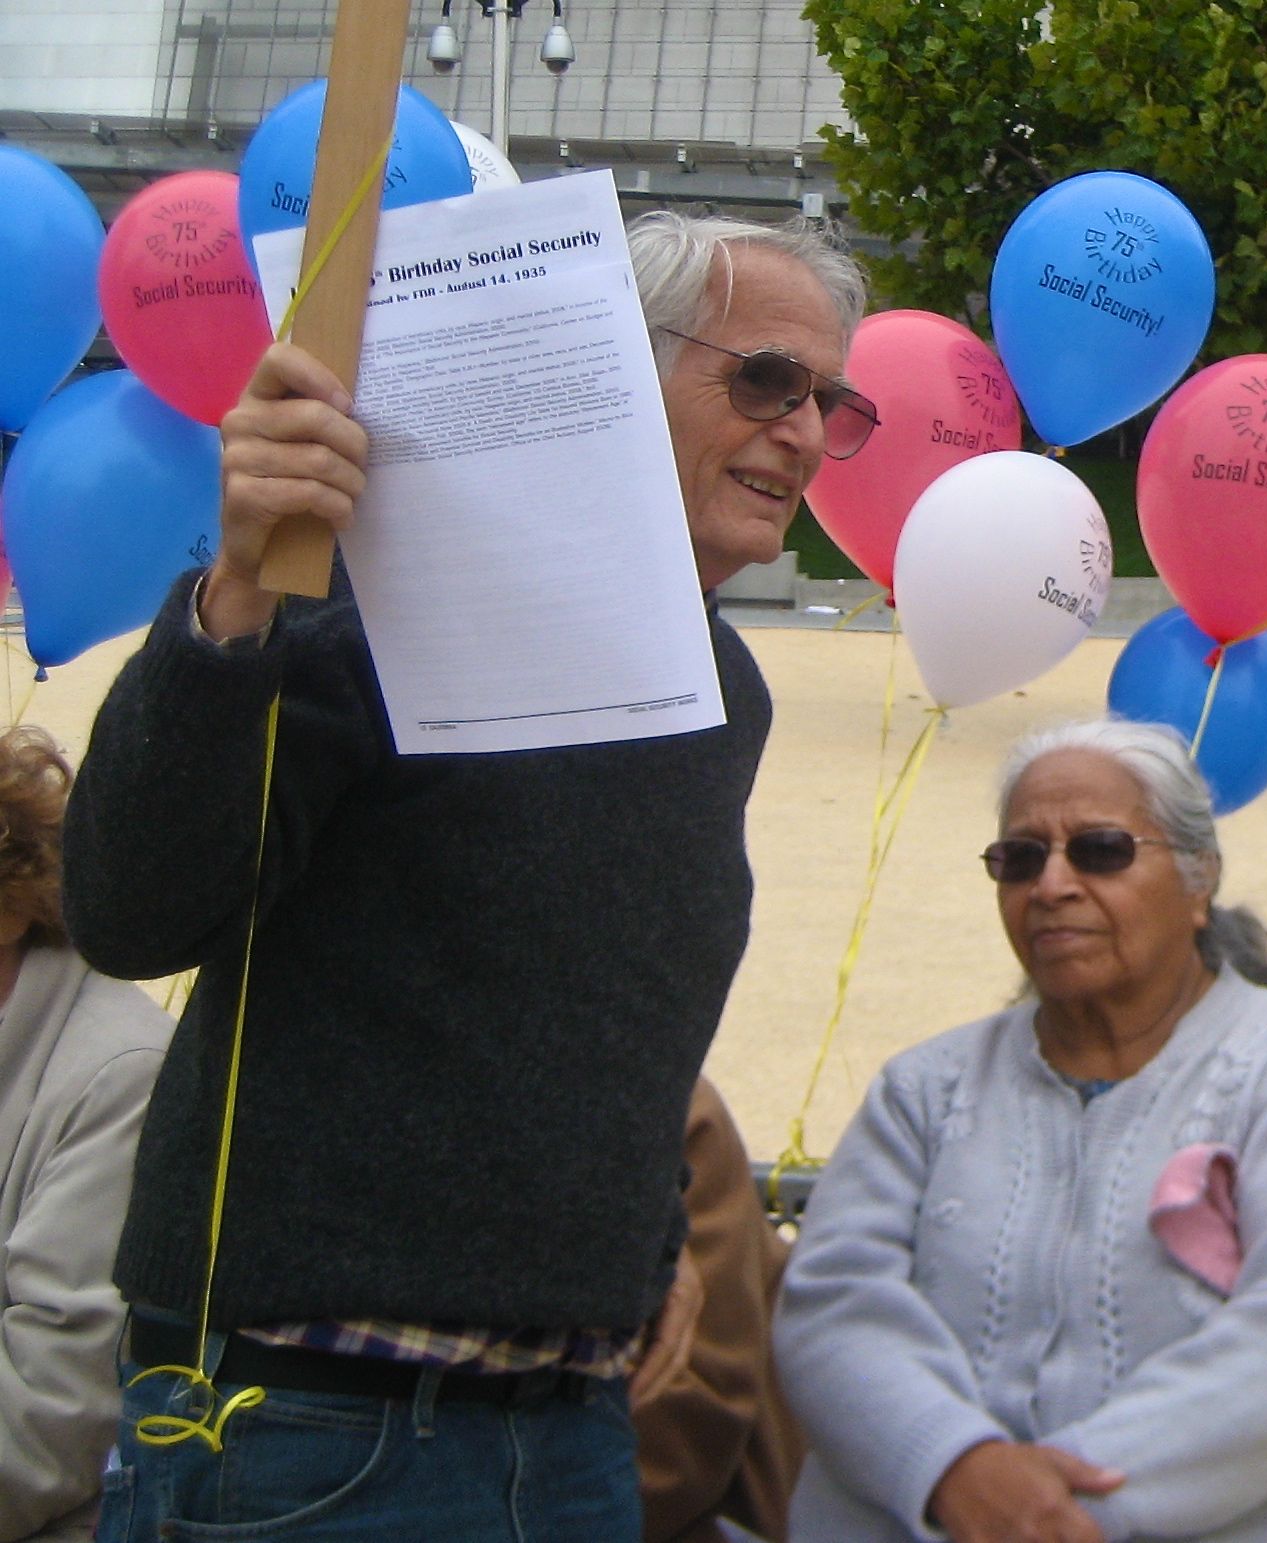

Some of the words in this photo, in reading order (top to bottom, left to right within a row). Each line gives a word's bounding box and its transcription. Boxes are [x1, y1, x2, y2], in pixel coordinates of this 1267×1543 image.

[271, 181, 311, 216] Soci
[1103, 207, 1160, 244] Happy
[388, 258, 462, 282] Birthday
[467, 242, 524, 267] Social
[527, 230, 602, 255] Security
[1084, 228, 1164, 284] Birthday
[132, 276, 180, 308] Social
[413, 287, 436, 300] FDR
[446, 278, 487, 294] August
[490, 274, 511, 286] 14,
[514, 266, 547, 282] 1935
[1038, 263, 1093, 302] Social
[1089, 285, 1165, 337] Security!
[931, 419, 982, 450] Social
[1192, 453, 1250, 483] Social
[1038, 576, 1084, 616] Social
